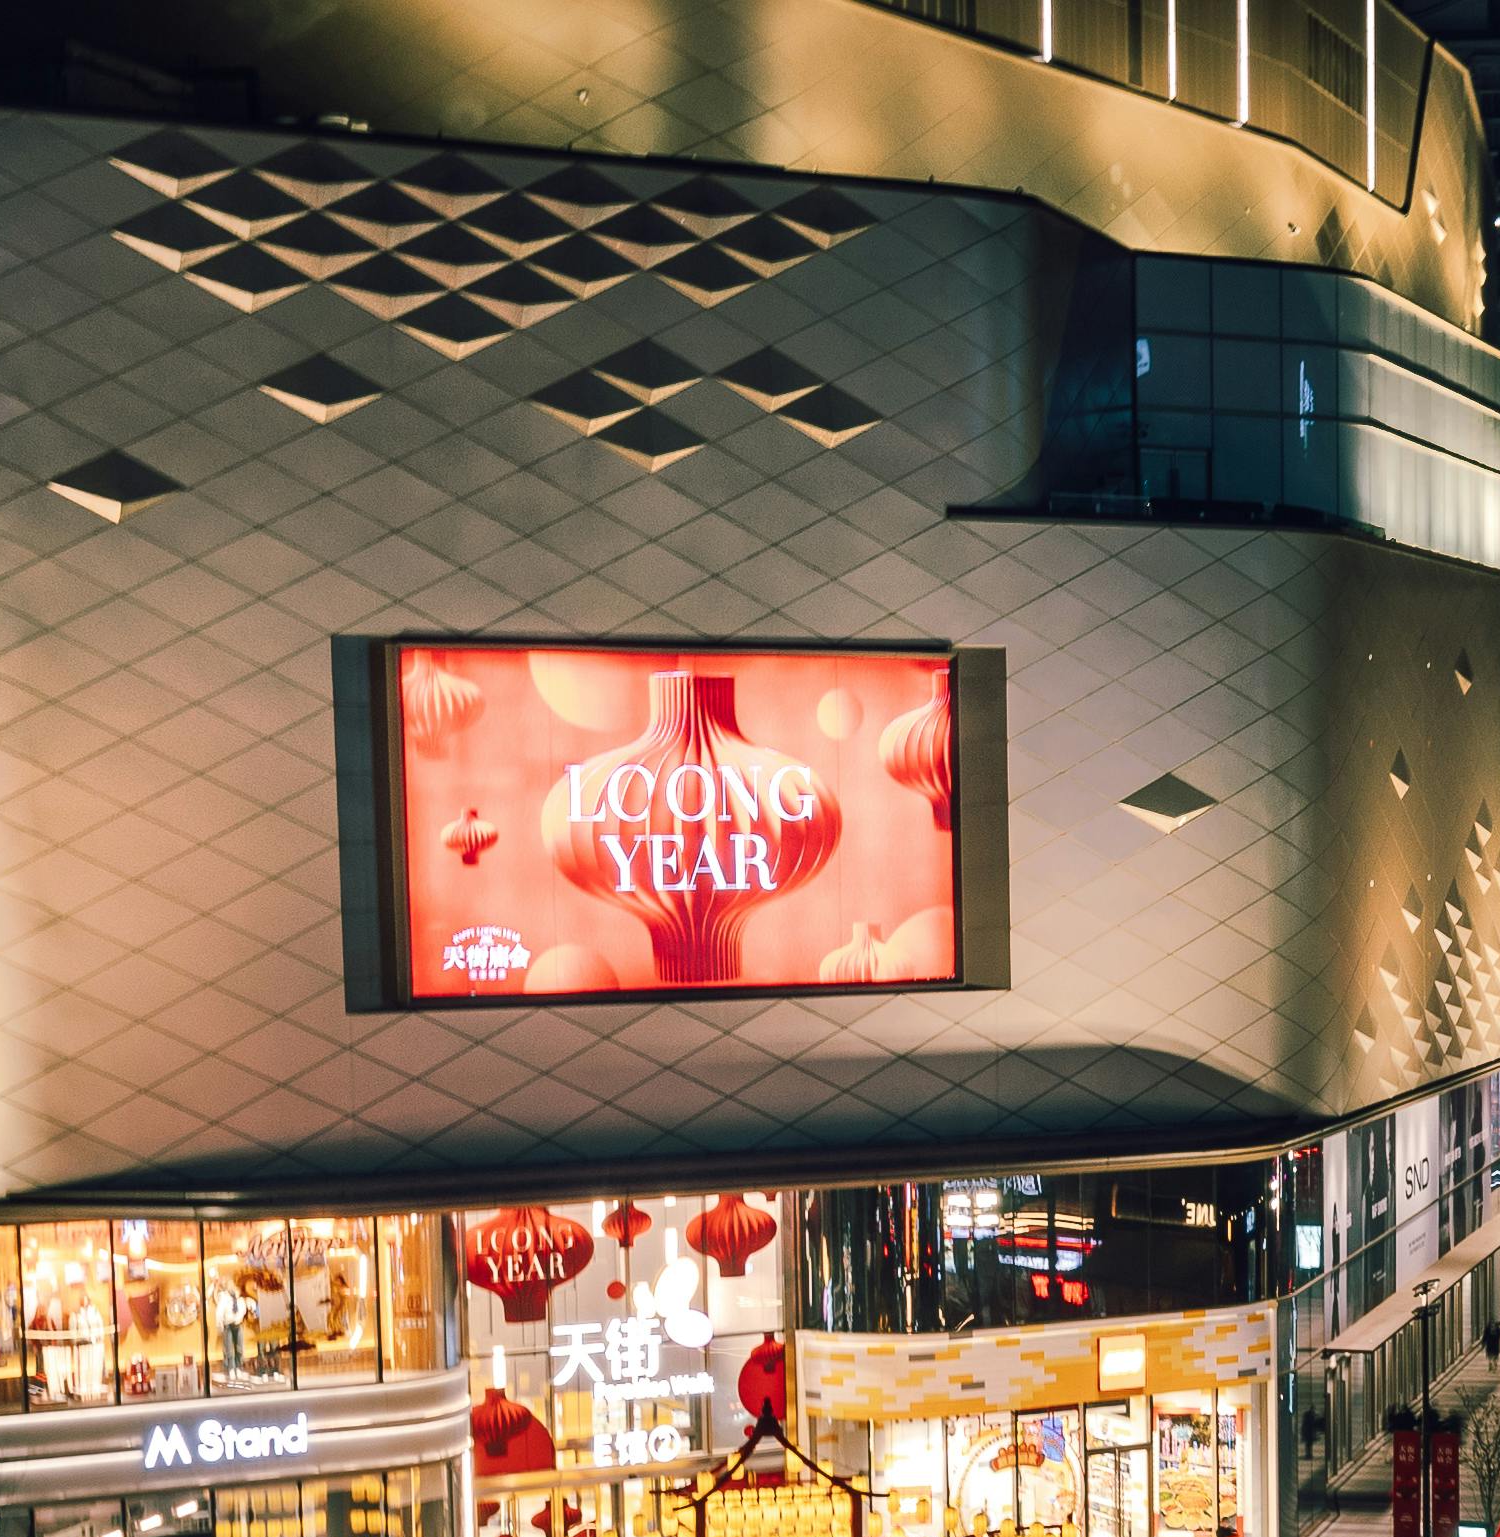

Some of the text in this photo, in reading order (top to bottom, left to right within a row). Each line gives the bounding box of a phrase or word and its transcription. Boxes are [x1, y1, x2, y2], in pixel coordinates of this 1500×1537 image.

[600, 834, 778, 893] YEAR
[1405, 1157, 1430, 1200] SND
[487, 1252, 566, 1283] YEAR
[550, 1316, 663, 1387] 天街
[144, 1412, 308, 1468] M Stand
